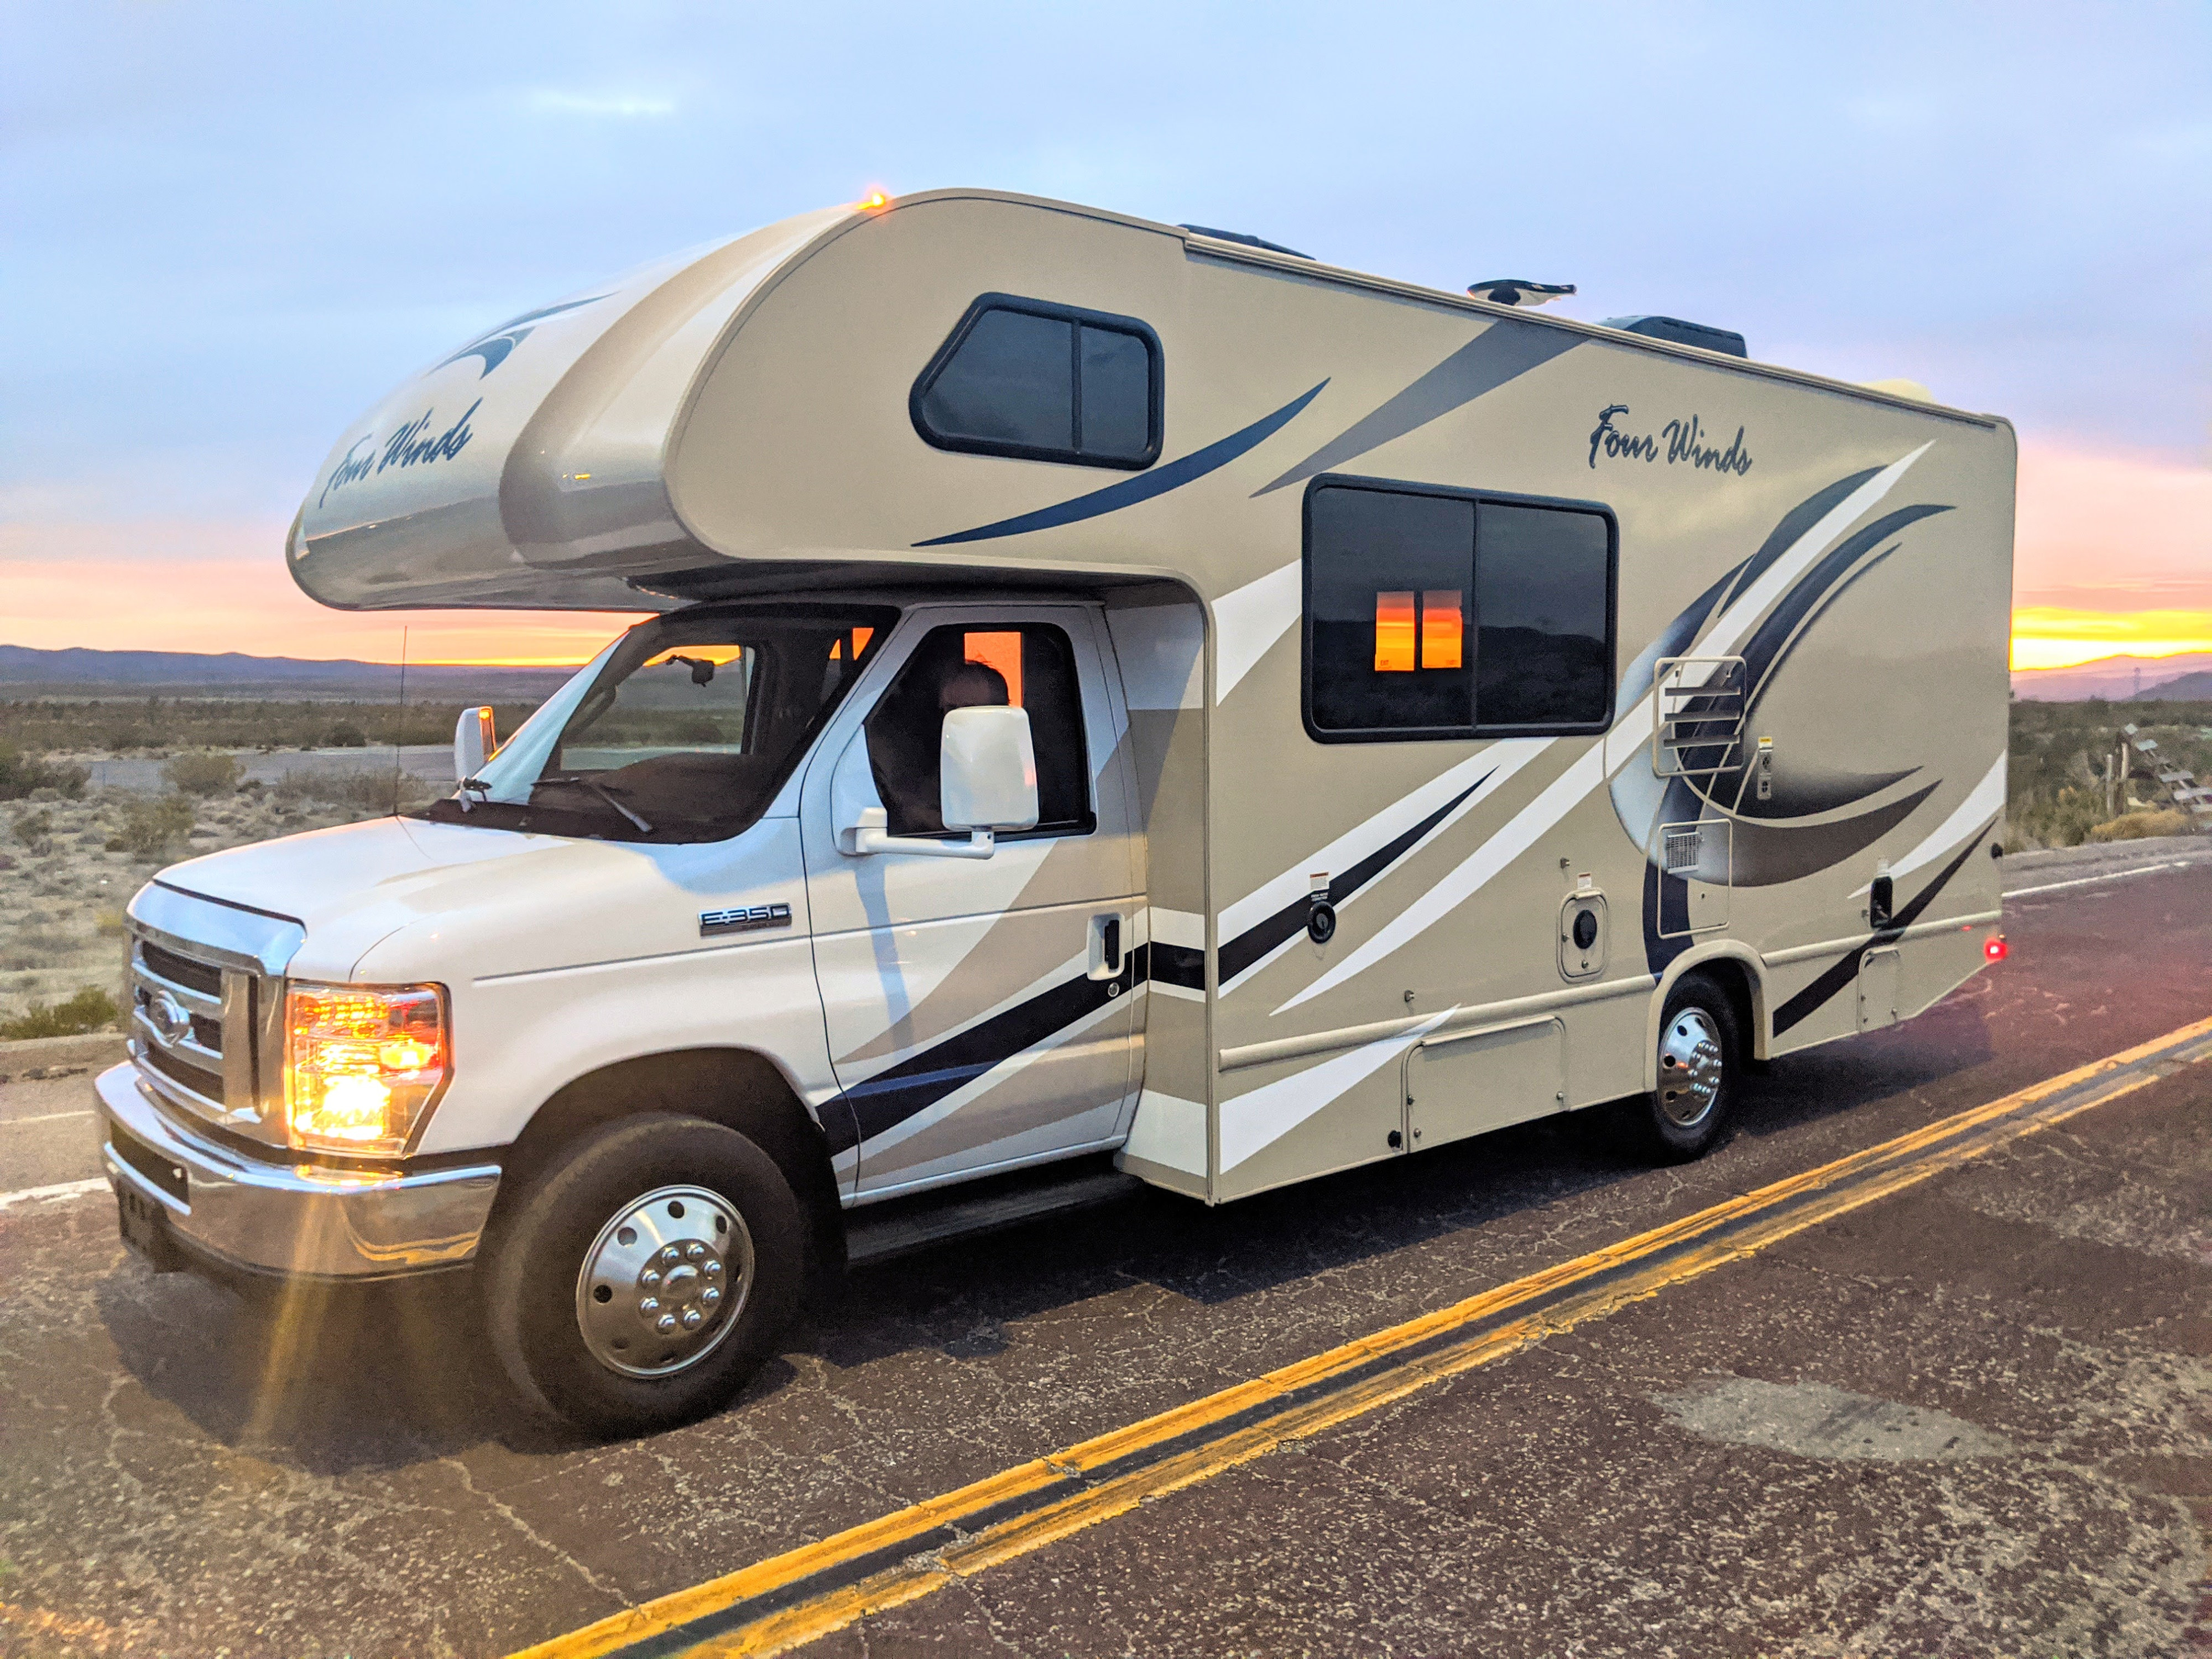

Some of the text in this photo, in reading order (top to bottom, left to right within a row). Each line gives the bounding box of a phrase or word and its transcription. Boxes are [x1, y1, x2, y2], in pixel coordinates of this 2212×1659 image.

[320, 397, 483, 509] Four Winds
[1589, 404, 1752, 476] Four Winds
[701, 905, 790, 926] E-350
